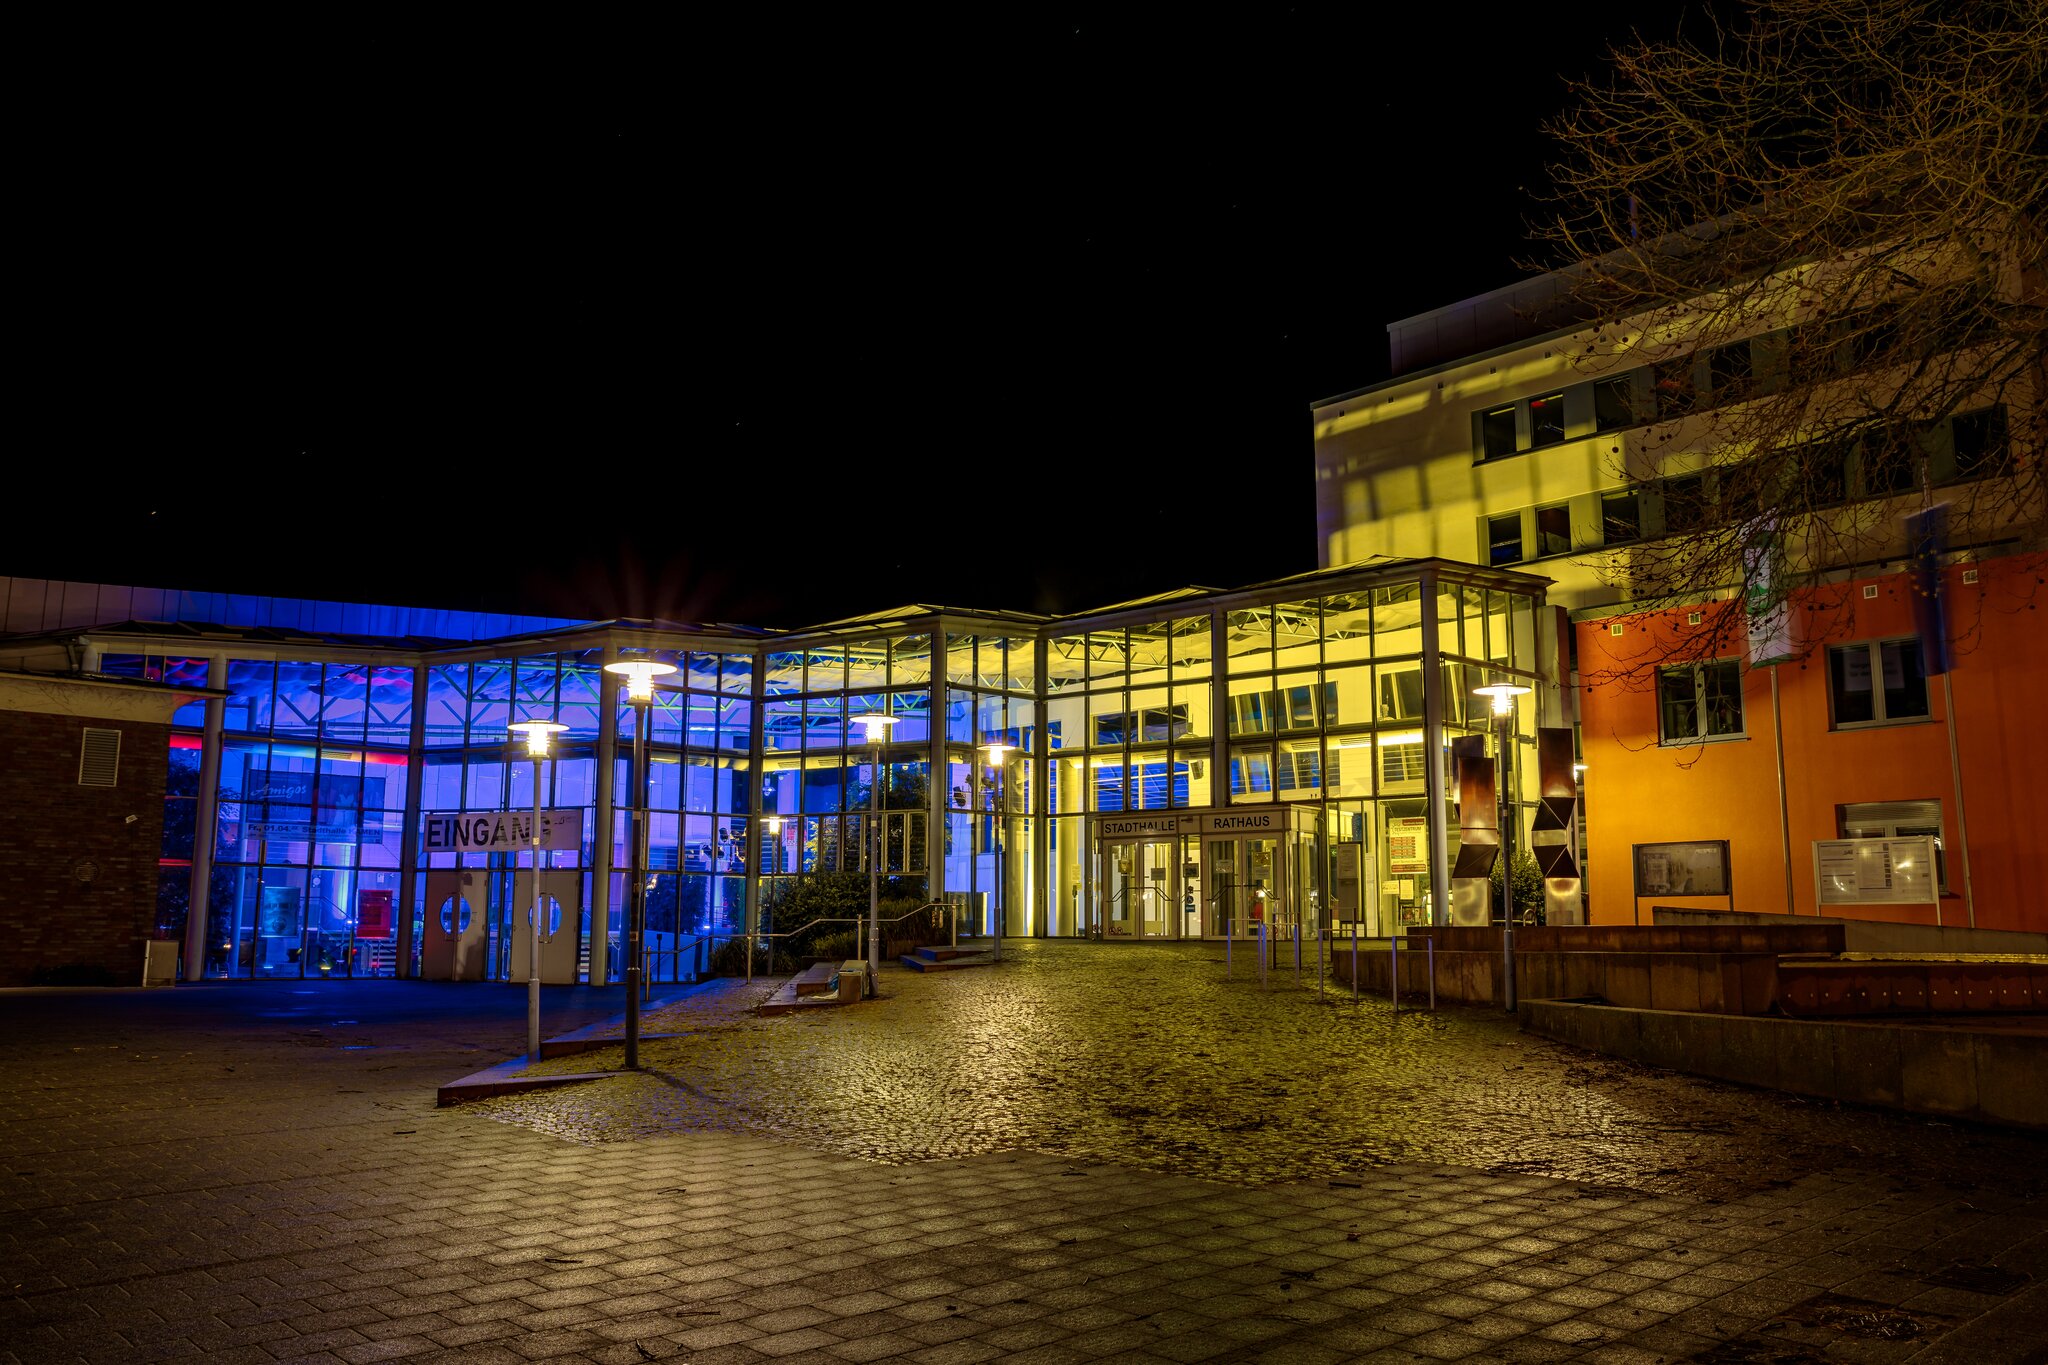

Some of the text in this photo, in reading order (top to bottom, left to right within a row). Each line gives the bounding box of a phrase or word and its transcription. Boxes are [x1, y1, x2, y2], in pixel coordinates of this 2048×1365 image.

[250, 782, 307, 799] Amigos
[1104, 820, 1176, 834] STADTHALLE
[1213, 815, 1271, 829] RATHAUS
[302, 826, 347, 834] Stadthalle
[348, 828, 381, 836] KAMEN
